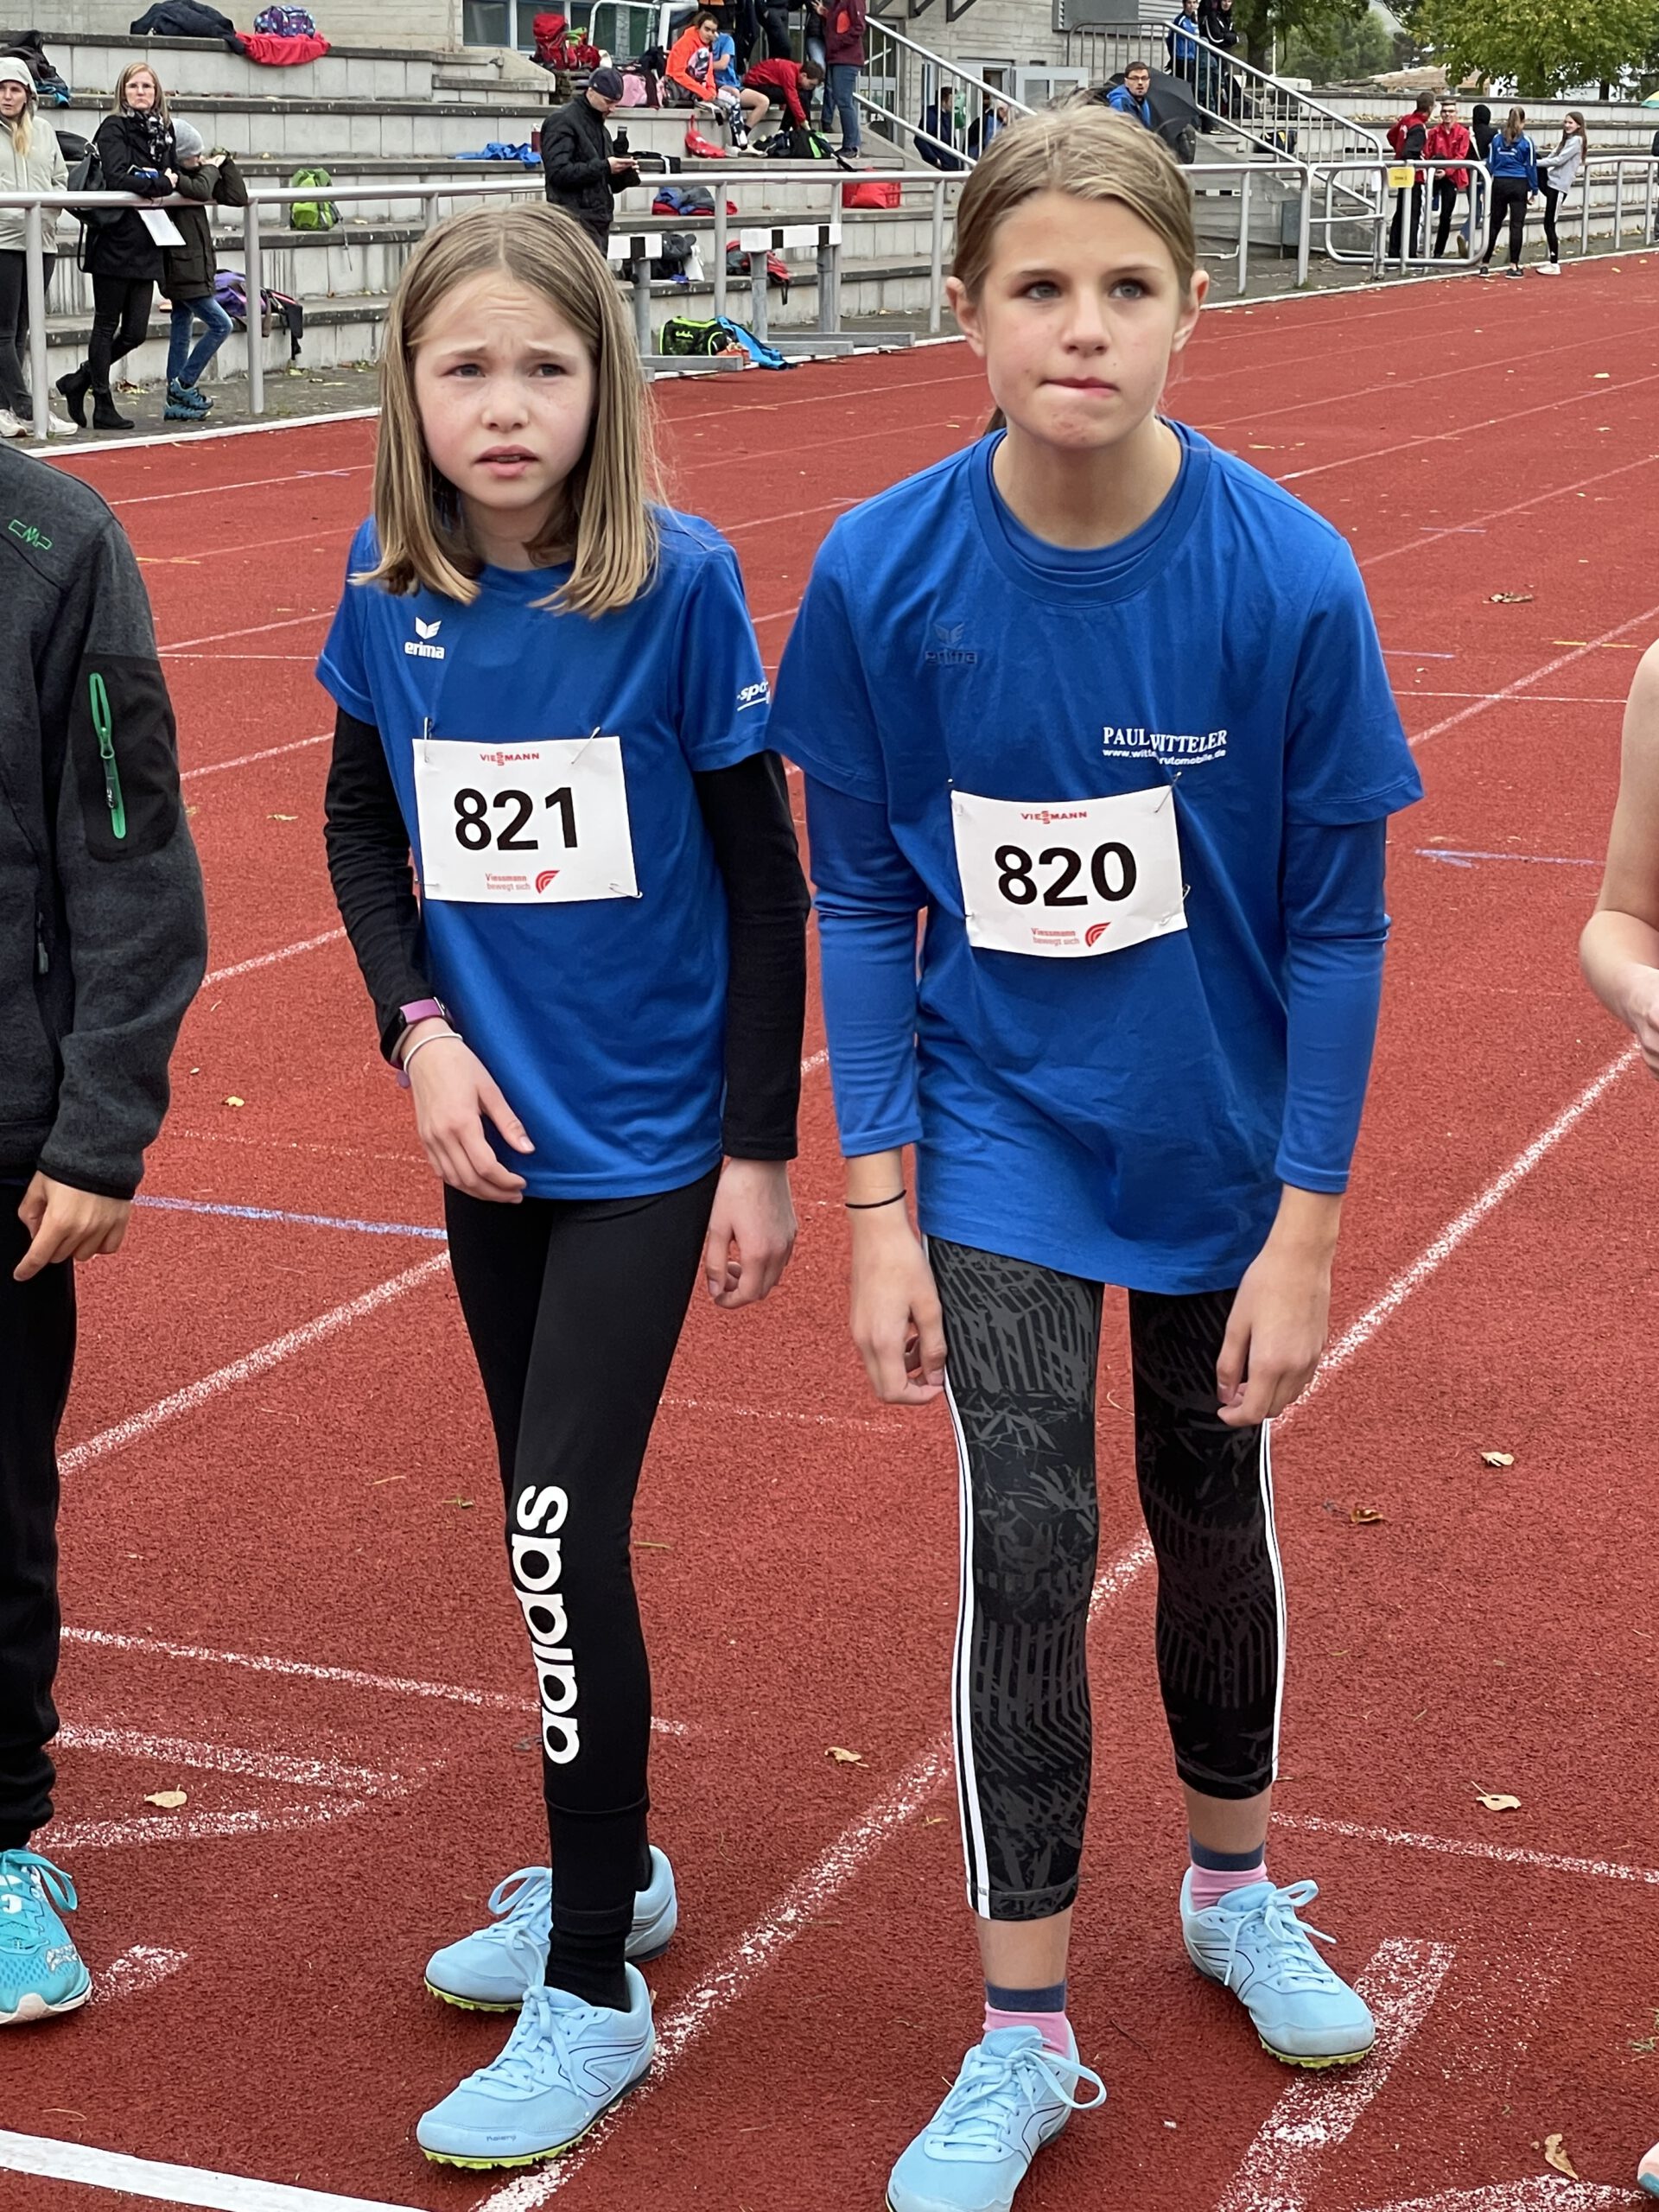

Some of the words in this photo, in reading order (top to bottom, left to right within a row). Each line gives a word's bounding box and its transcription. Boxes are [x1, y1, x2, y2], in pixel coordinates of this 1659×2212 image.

[404, 640, 445, 659] erima
[925, 649, 978, 665] erima
[1103, 727, 1151, 746] PAUL
[1149, 729, 1228, 753] WITTELER
[480, 752, 540, 766] VIESSMANN
[454, 787, 578, 850] 821
[1020, 810, 1088, 824] VIESSMANN
[995, 842, 1137, 906] 820
[512, 1485, 580, 1764] adidas
